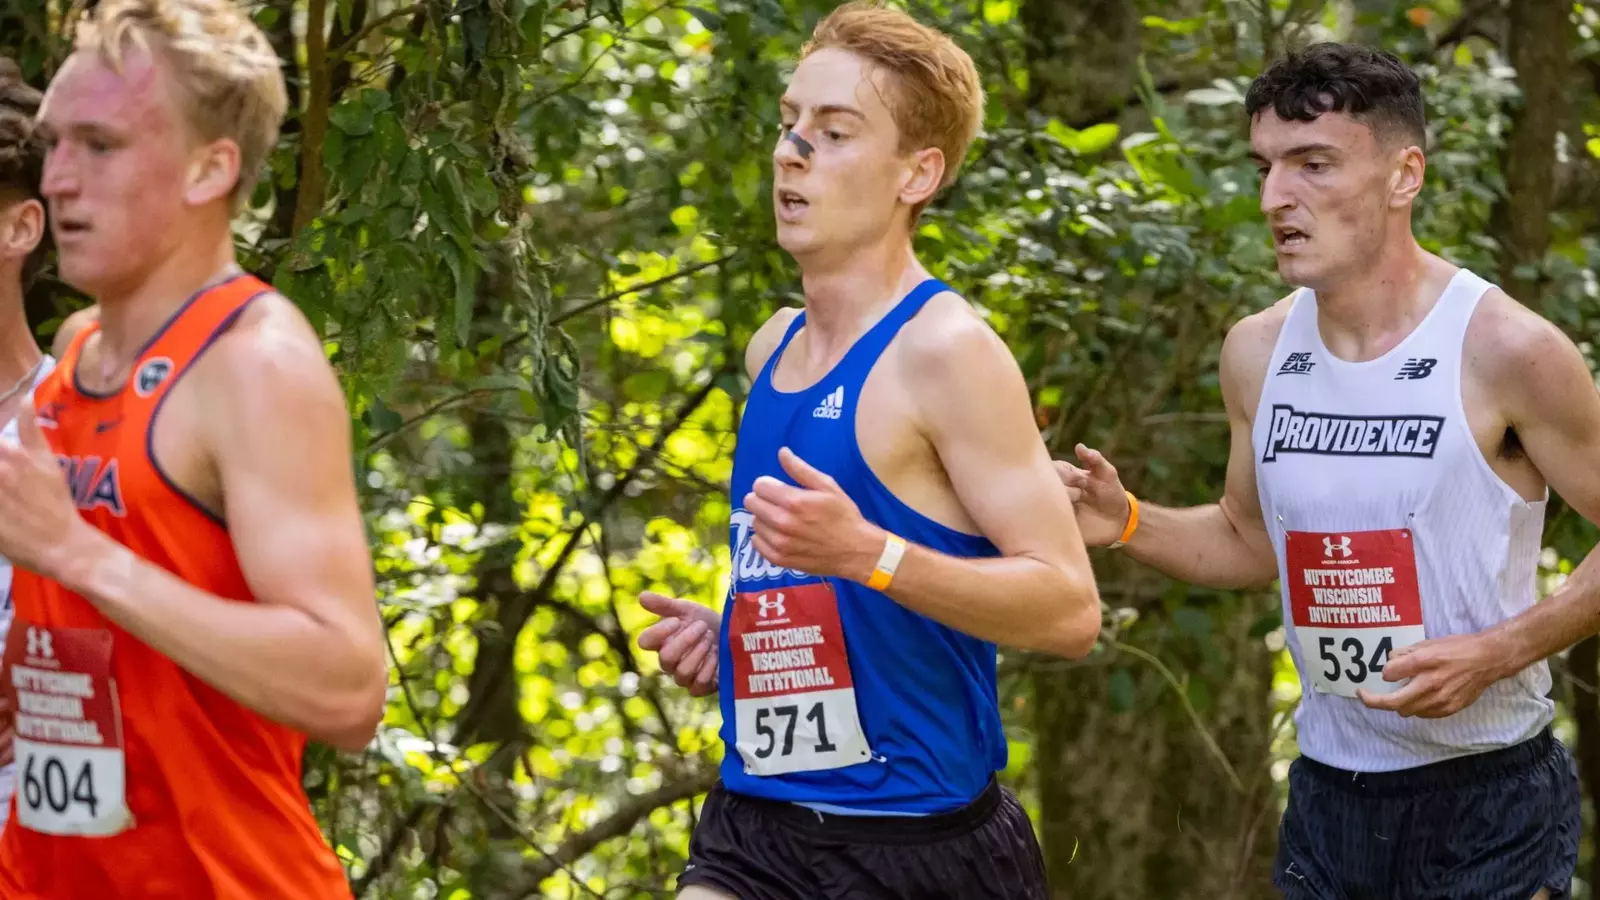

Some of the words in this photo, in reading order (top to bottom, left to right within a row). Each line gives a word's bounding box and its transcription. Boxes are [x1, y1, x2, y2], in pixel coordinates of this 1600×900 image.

[1280, 362, 1316, 372] EAST
[1286, 352, 1312, 362] BIG
[1262, 404, 1446, 463] PROVIDENCE
[1303, 567, 1395, 586] NUTTYCOMBE
[1312, 587, 1383, 605] WISCONSIN
[1308, 605, 1401, 624] INVITATIONAL
[741, 625, 825, 651] NUTTYCOMBE
[1318, 636, 1393, 684] 534
[754, 702, 836, 759] 571
[24, 754, 97, 818] 604
